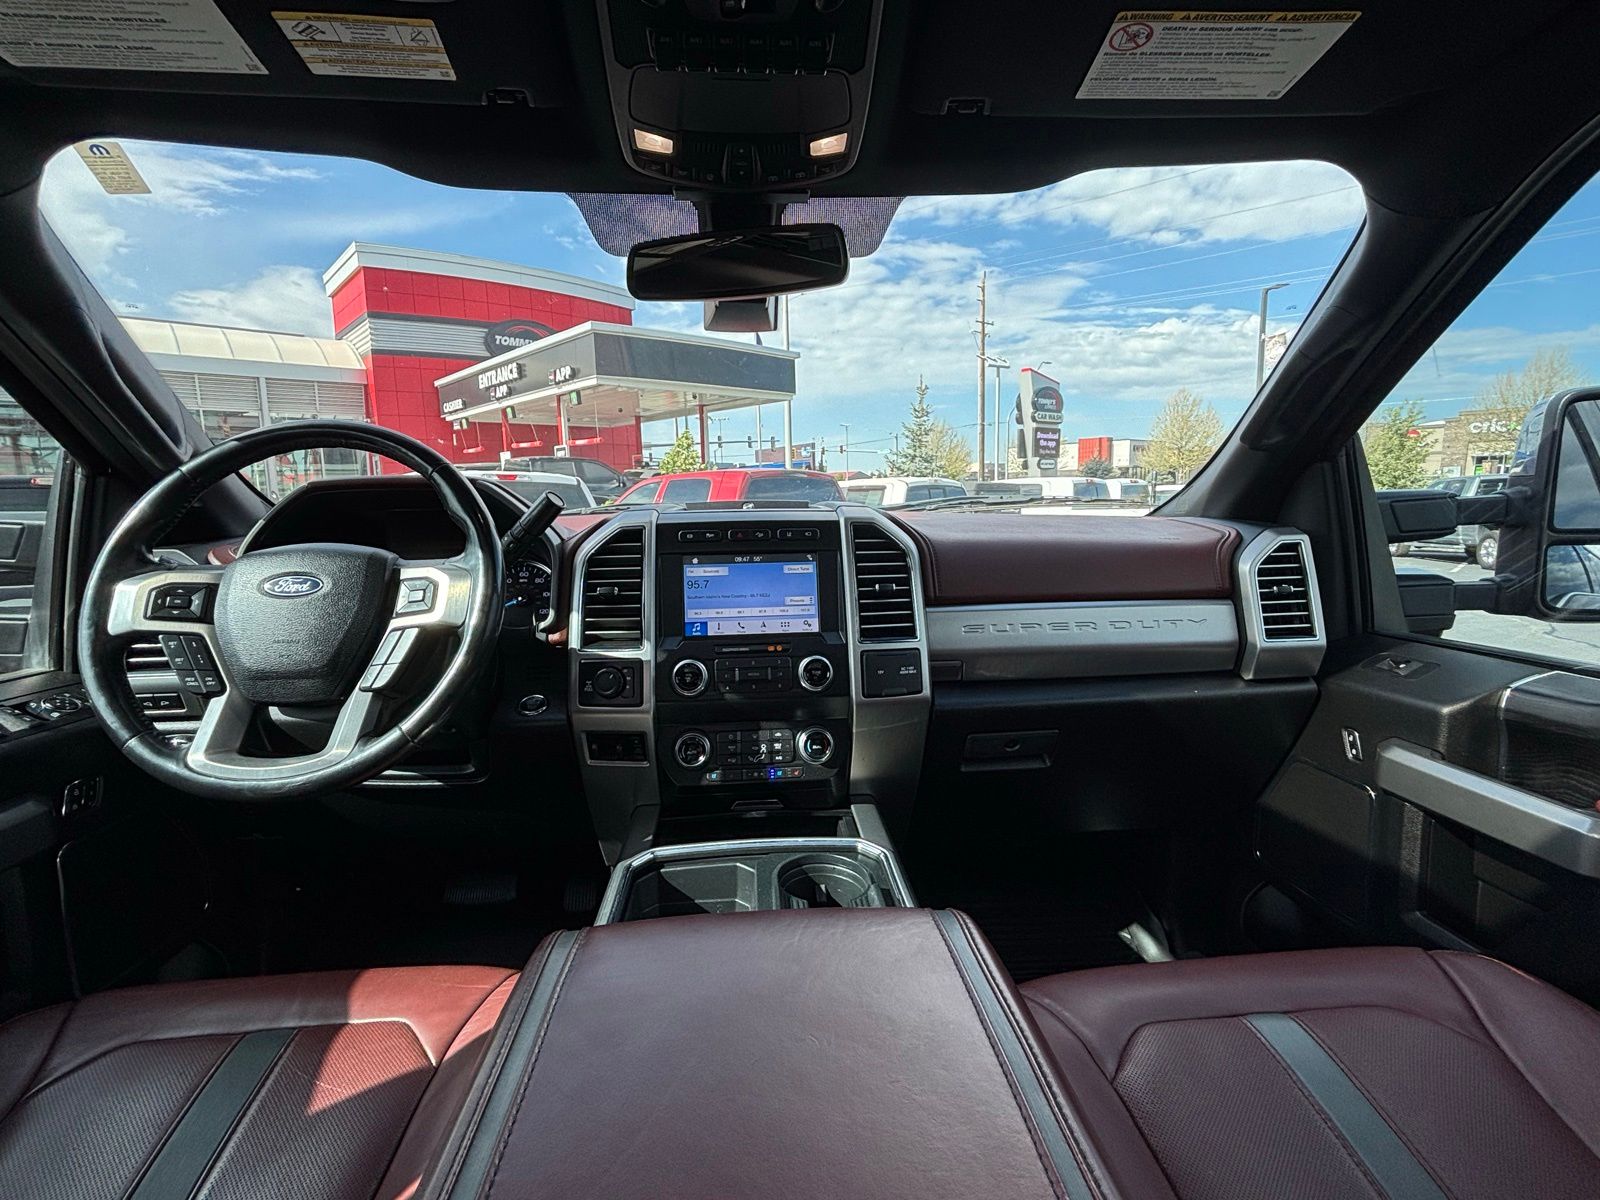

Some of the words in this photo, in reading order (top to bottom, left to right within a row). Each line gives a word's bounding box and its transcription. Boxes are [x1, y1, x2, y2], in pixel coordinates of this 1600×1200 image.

[1129, 13, 1174, 21] WARNING
[1192, 13, 1271, 21] AVERTISSEMENT
[1288, 13, 1356, 21] ADVERTENCIA
[478, 362, 519, 390] ENTRANCE
[556, 365, 571, 382] APP
[495, 384, 507, 398] APP
[443, 398, 464, 413] CASHIER
[519, 570, 530, 579] 60
[535, 576, 546, 584] 80
[274, 579, 311, 593] Ford
[687, 580, 710, 589] 95.7
[962, 621, 1098, 635] SUPER
[1107, 618, 1207, 630] DUTY
